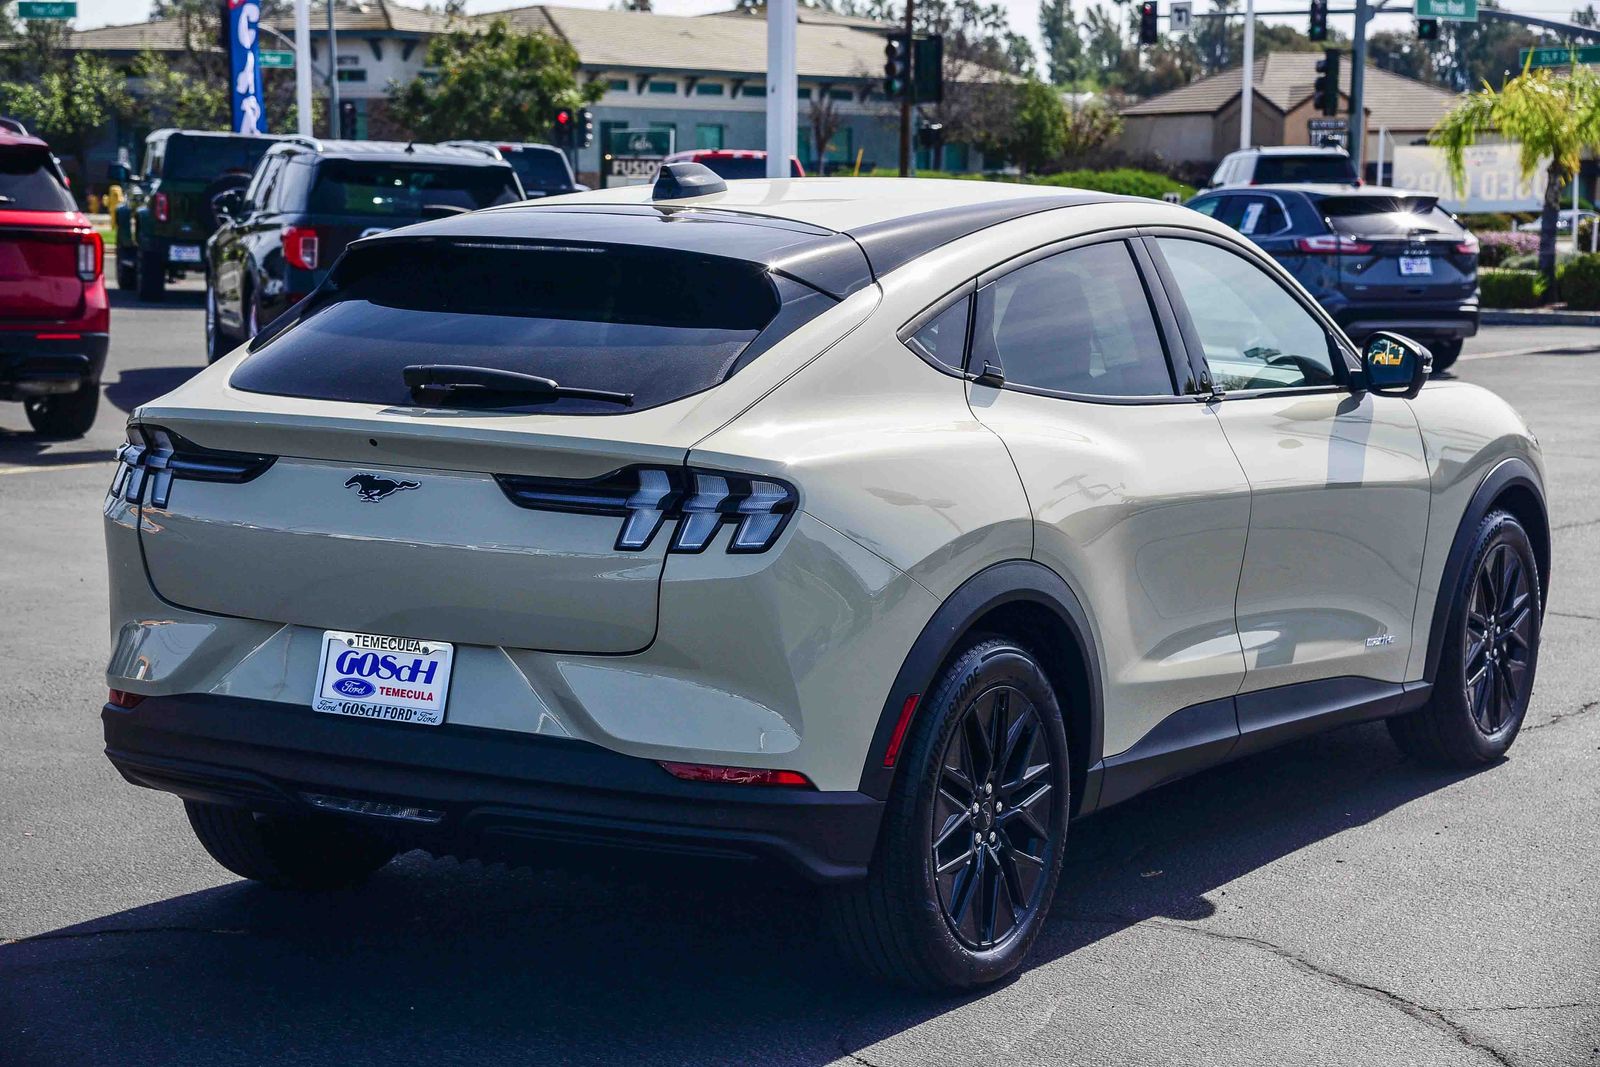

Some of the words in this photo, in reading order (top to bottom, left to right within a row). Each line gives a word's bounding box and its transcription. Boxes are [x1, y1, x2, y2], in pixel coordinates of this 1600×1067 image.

[355, 634, 421, 653] TEMECULA
[341, 682, 365, 694] Ford
[379, 686, 434, 701] TEMECULA
[317, 700, 337, 711] Ford
[383, 706, 412, 721] FORD
[417, 711, 437, 723] Ford
